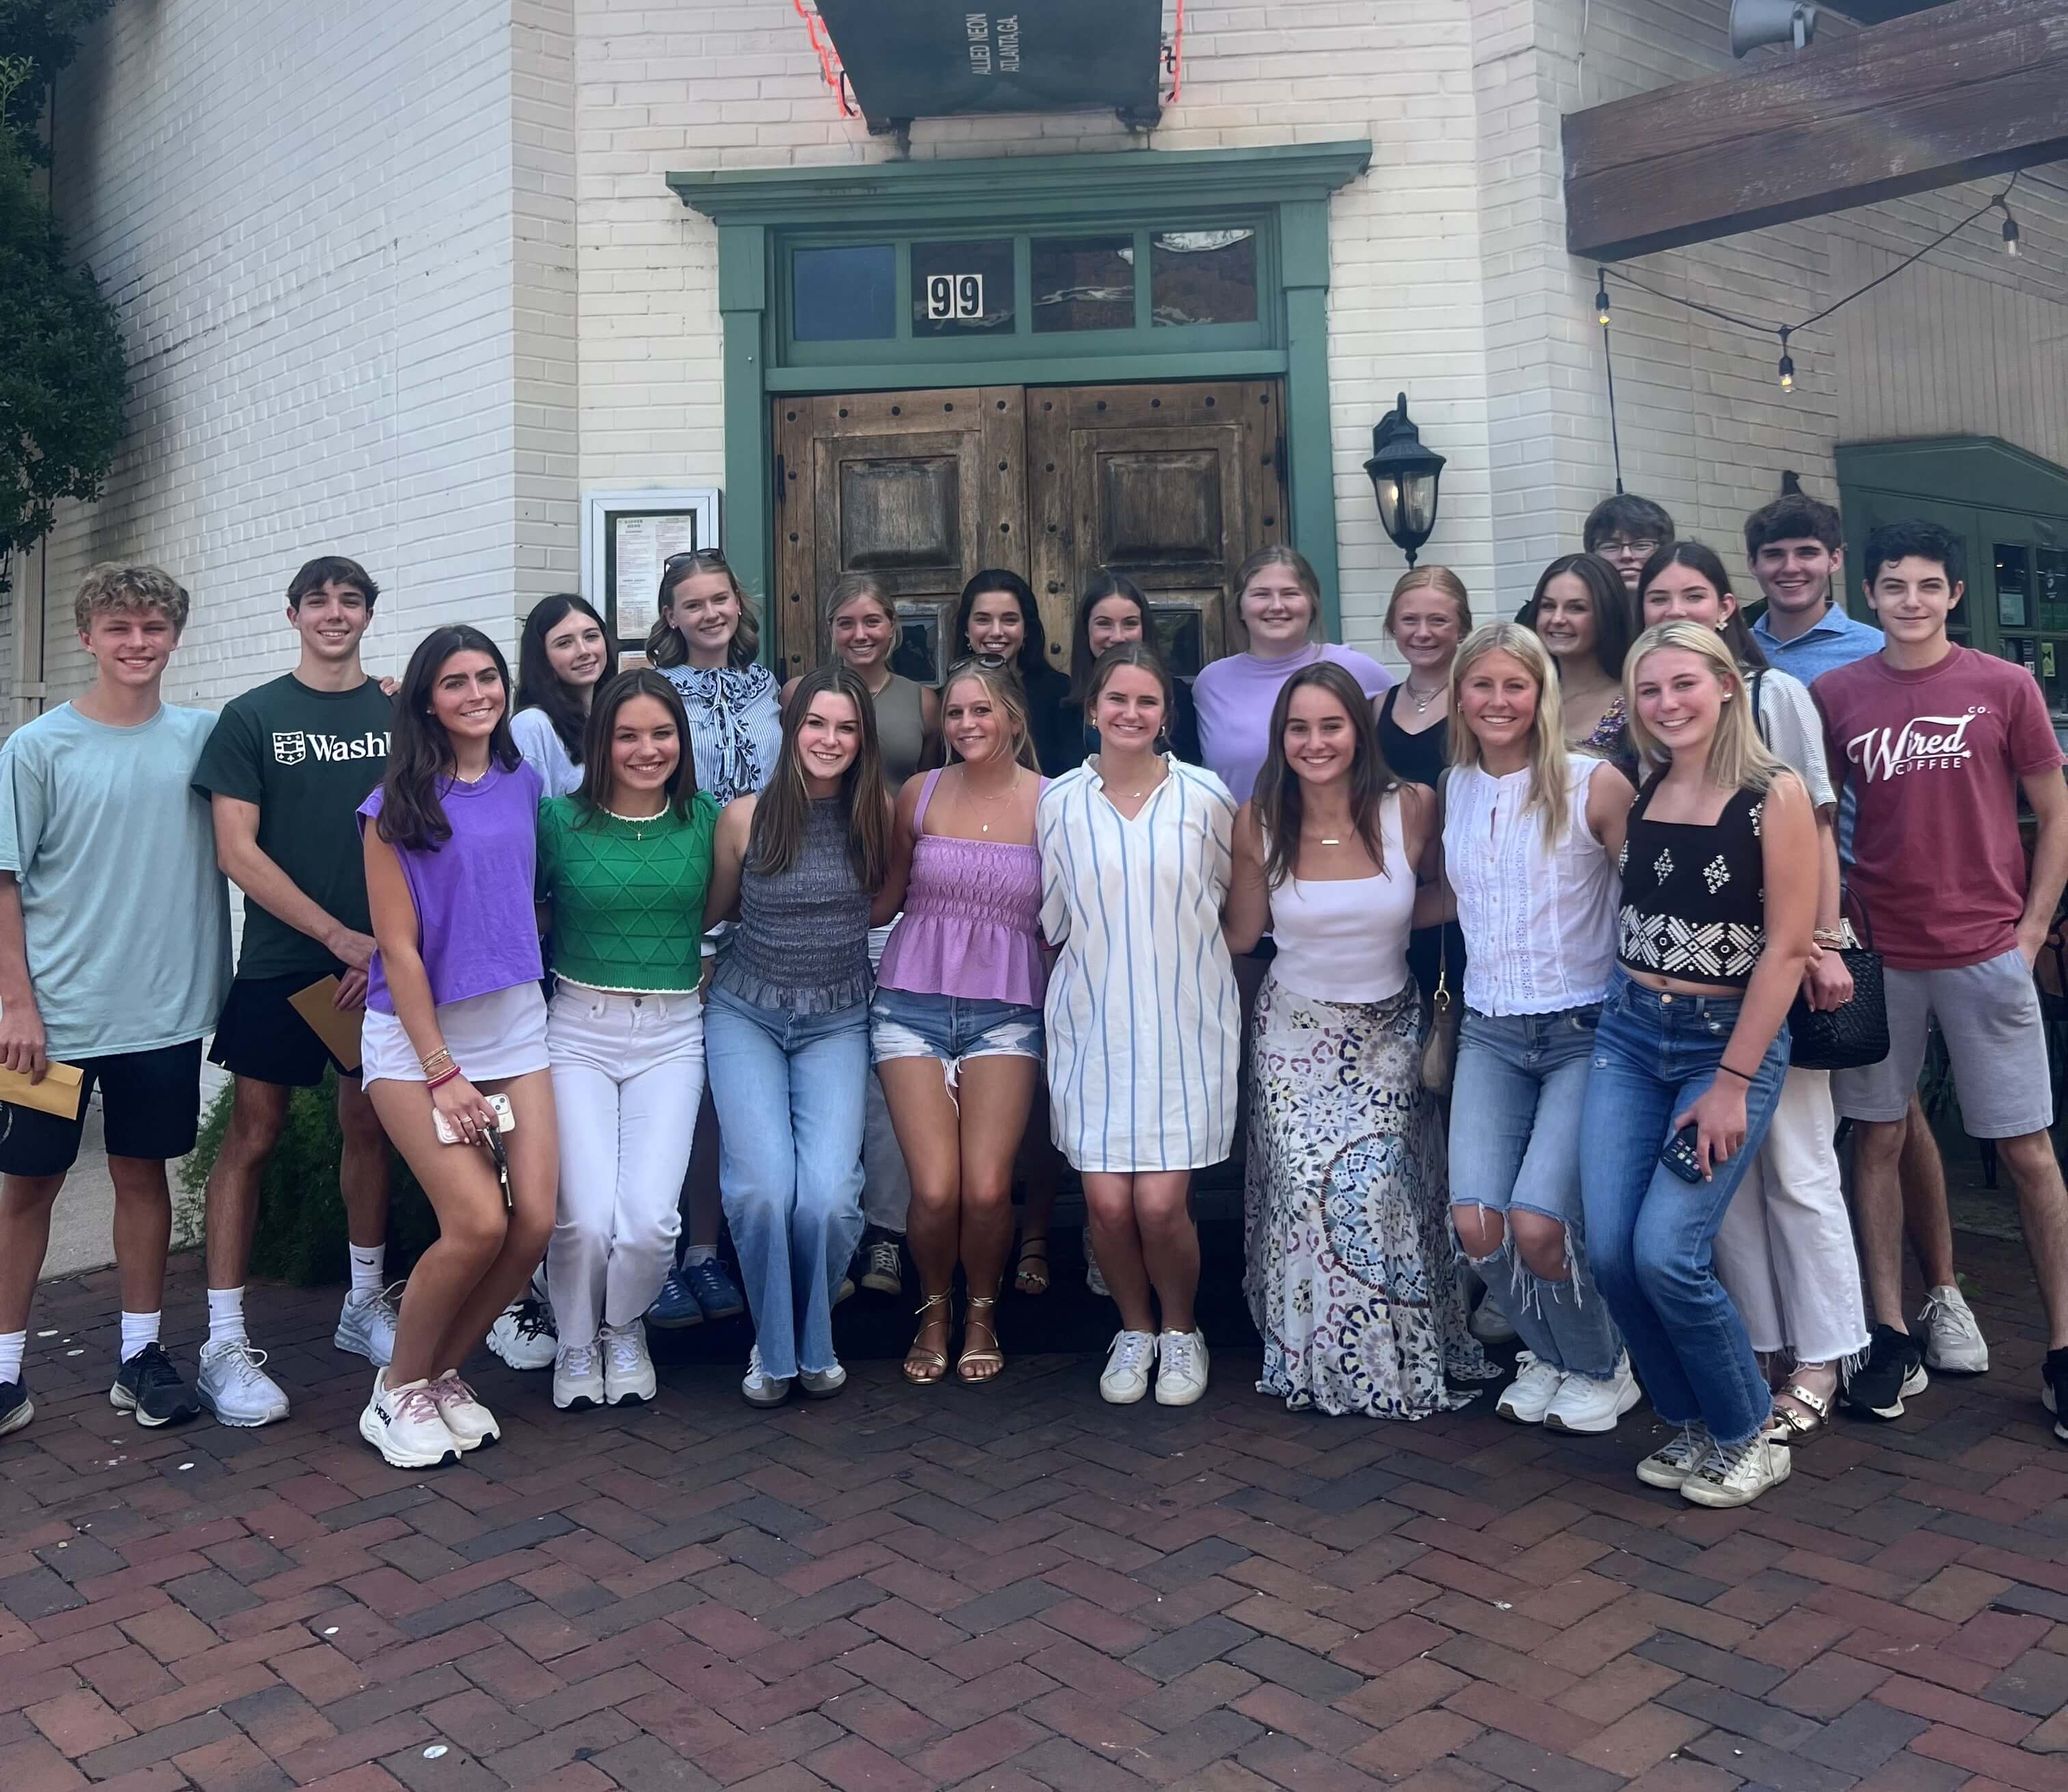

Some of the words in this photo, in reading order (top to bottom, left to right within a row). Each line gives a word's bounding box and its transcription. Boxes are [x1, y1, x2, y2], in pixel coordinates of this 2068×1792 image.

[965, 13, 990, 41] NEON
[970, 44, 992, 75] ALLIED
[931, 276, 979, 317] 99
[1846, 714, 1976, 784] Wired
[374, 1402, 392, 1428] HOKA
